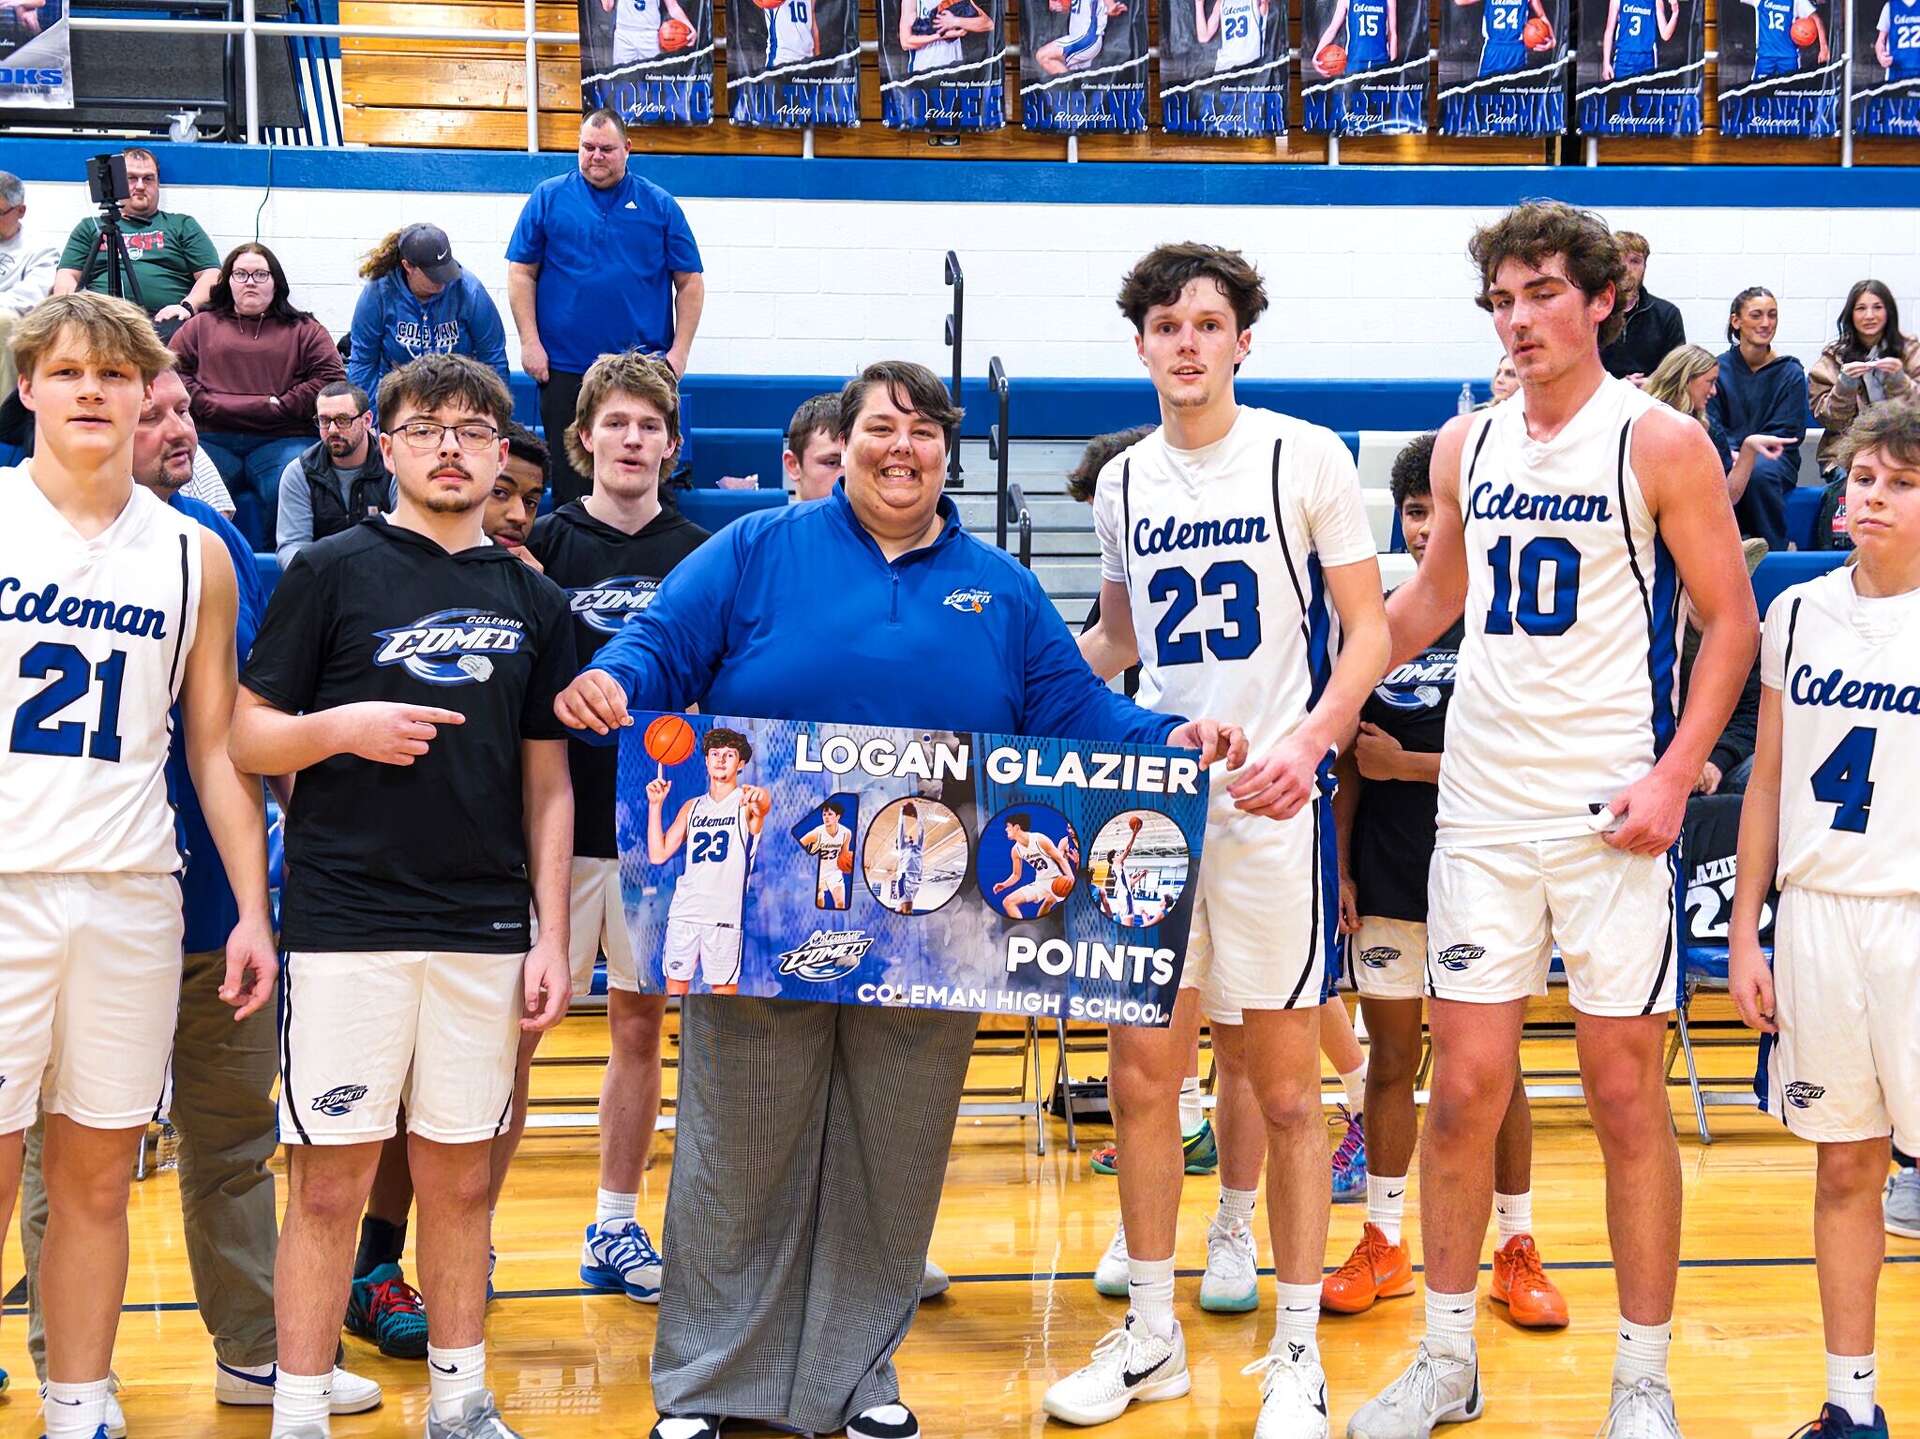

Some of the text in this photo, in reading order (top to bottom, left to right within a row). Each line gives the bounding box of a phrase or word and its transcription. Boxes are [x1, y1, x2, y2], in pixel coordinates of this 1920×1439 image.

[788, 0, 808, 24] 10
[1353, 3, 1384, 14] Coleman
[1493, 7, 1518, 29] 24
[1622, 3, 1651, 16] Coleman
[1768, 10, 1785, 31] 12
[1225, 15, 1248, 40] 23
[1359, 14, 1379, 36] 15
[1628, 15, 1641, 36] 3
[1897, 25, 1920, 49] 22
[776, 104, 811, 115] Aden
[924, 108, 965, 119] Ethan
[1201, 112, 1244, 127] Logan
[1608, 113, 1665, 125] Brennan
[1472, 481, 1613, 522] Coleman
[1133, 515, 1271, 557] Coleman
[1484, 535, 1582, 637] 10
[0, 576, 167, 640] Coleman
[569, 589, 657, 612] COM
[465, 616, 524, 629] COLEMAN
[1147, 559, 1263, 668] 23
[376, 626, 521, 664] COMETS
[9, 640, 128, 763] 21
[1790, 664, 1920, 715] Colema
[795, 733, 1199, 795] LOGAN GLAZIER
[1810, 726, 1877, 834] 4
[691, 815, 736, 828] Coleman
[691, 830, 730, 864] 23
[820, 849, 839, 860] 23
[782, 941, 870, 971] COMETS
[1006, 936, 1176, 986] POINTS
[857, 983, 1164, 1024] COLEMAN HIGH SCHOOL
